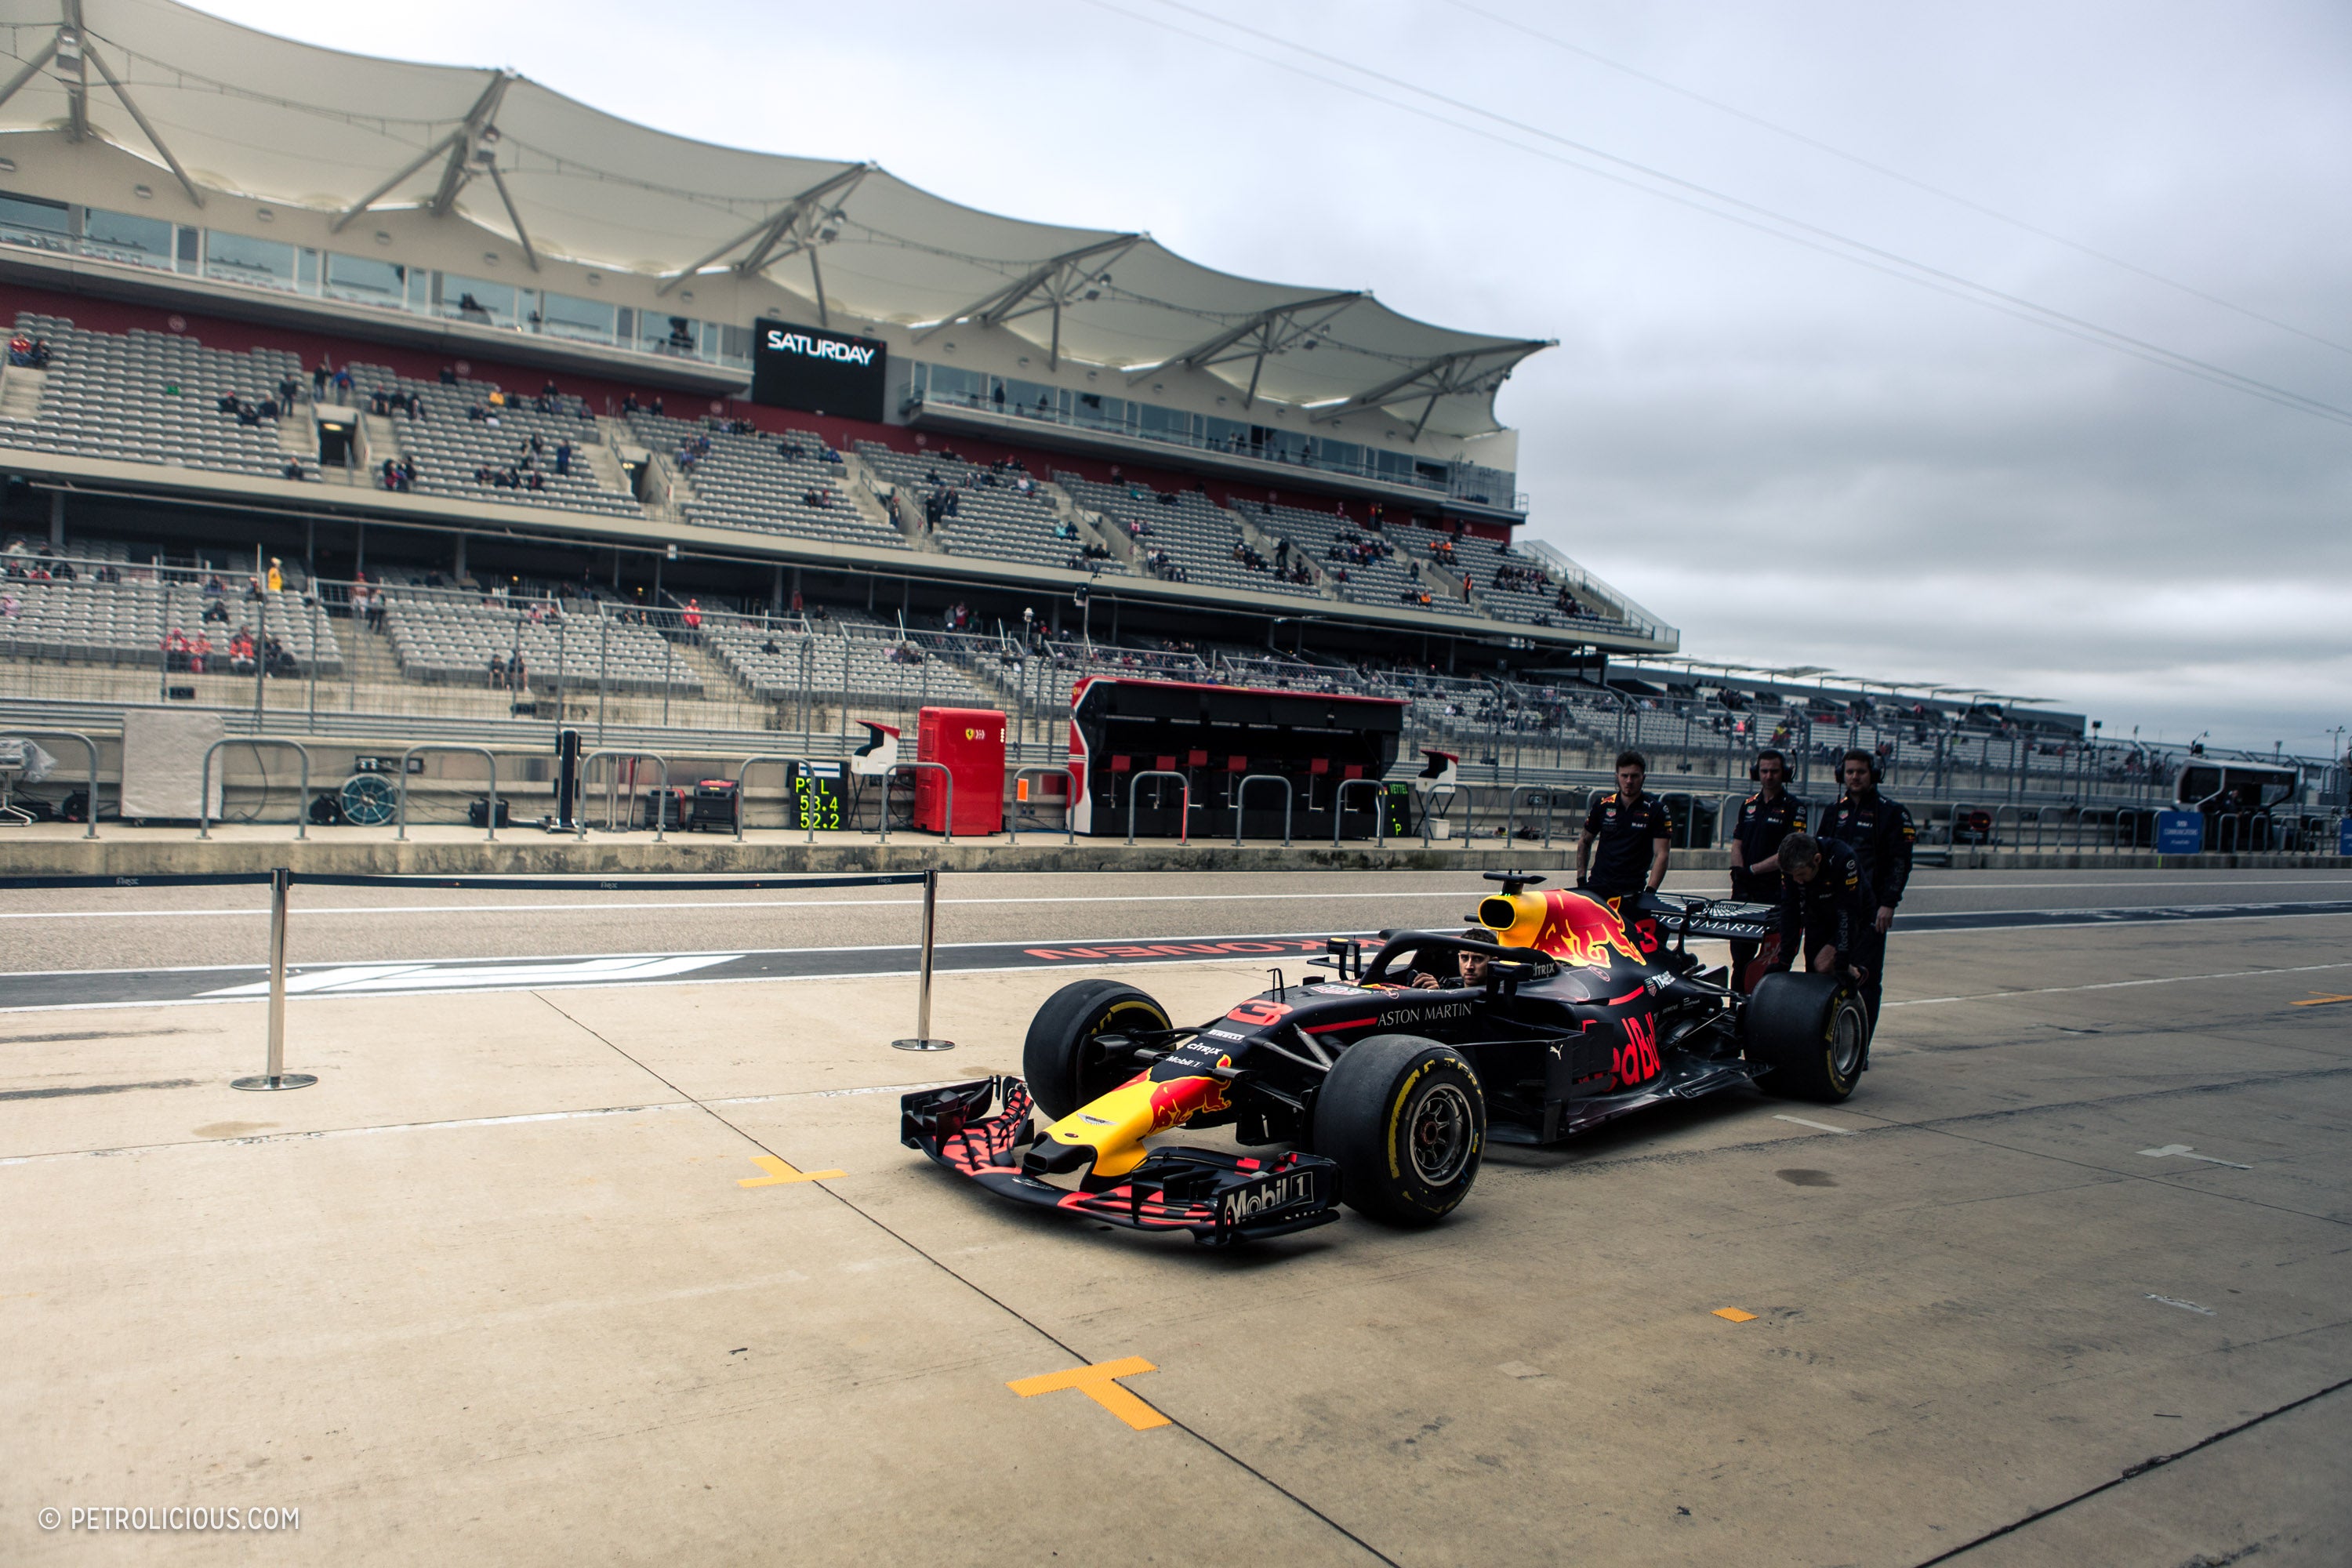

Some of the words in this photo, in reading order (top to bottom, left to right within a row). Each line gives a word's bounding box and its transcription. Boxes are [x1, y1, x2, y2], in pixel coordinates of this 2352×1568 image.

[767, 330, 875, 366] SATURDAY
[821, 779, 829, 795] L
[1390, 784, 1408, 794] VETTEL
[800, 812, 840, 829] 52.2
[1533, 962, 1555, 978] ITRIX
[1377, 1008, 1420, 1027] ASTON
[1425, 1003, 1472, 1021] MARTIN
[1166, 1055, 1192, 1066] Mobil
[1225, 1178, 1287, 1225] Mobil
